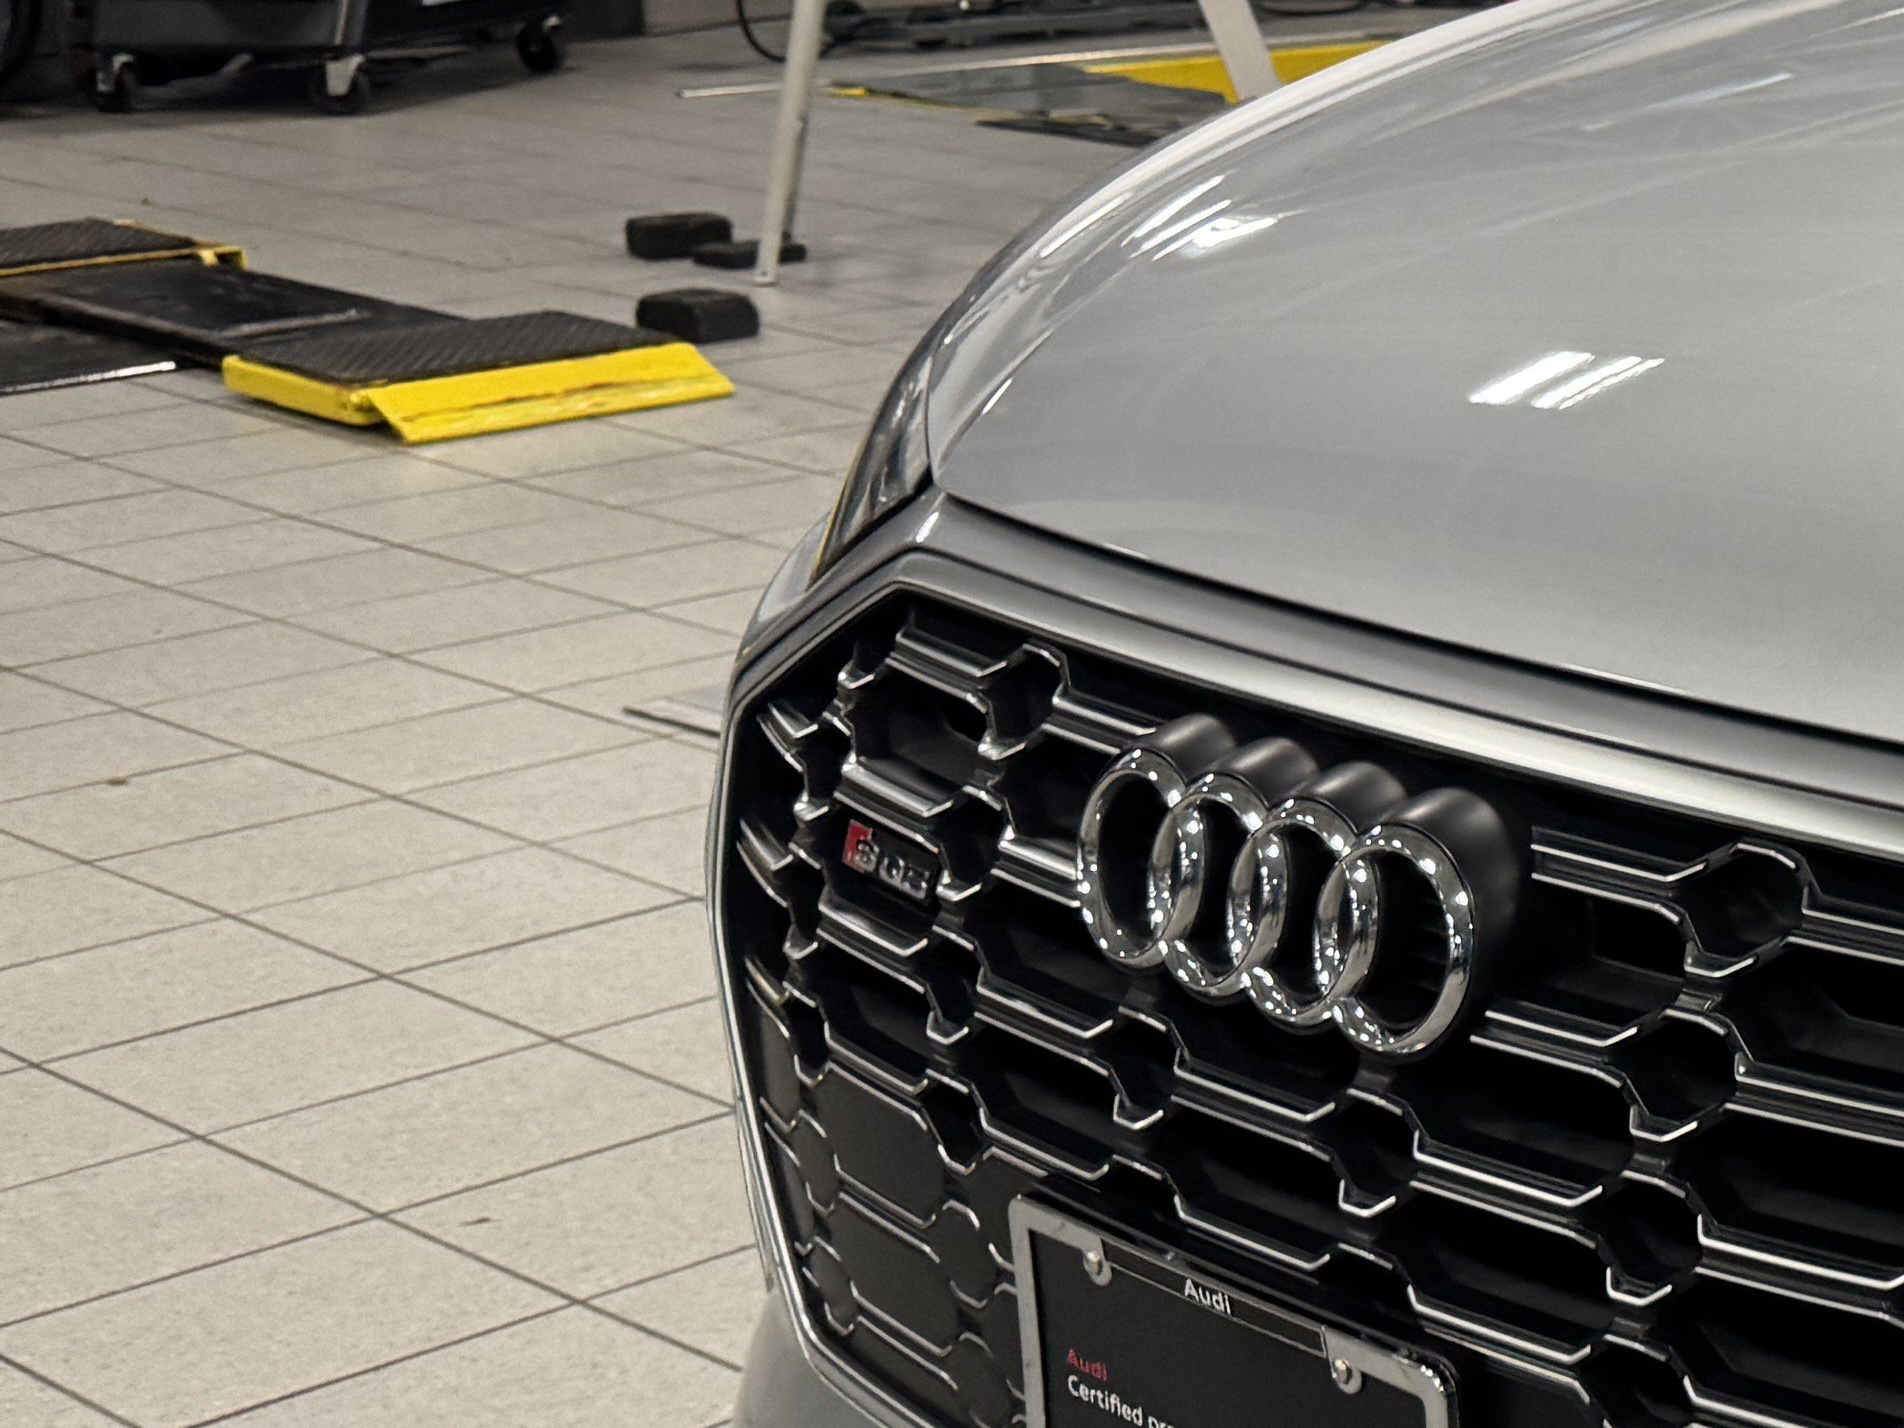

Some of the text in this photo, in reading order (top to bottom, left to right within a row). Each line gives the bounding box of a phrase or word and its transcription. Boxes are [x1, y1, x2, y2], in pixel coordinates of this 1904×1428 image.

[1184, 1278, 1231, 1314] Audi
[1066, 1348, 1108, 1381] Audi
[1067, 1374, 1144, 1427] Certified
